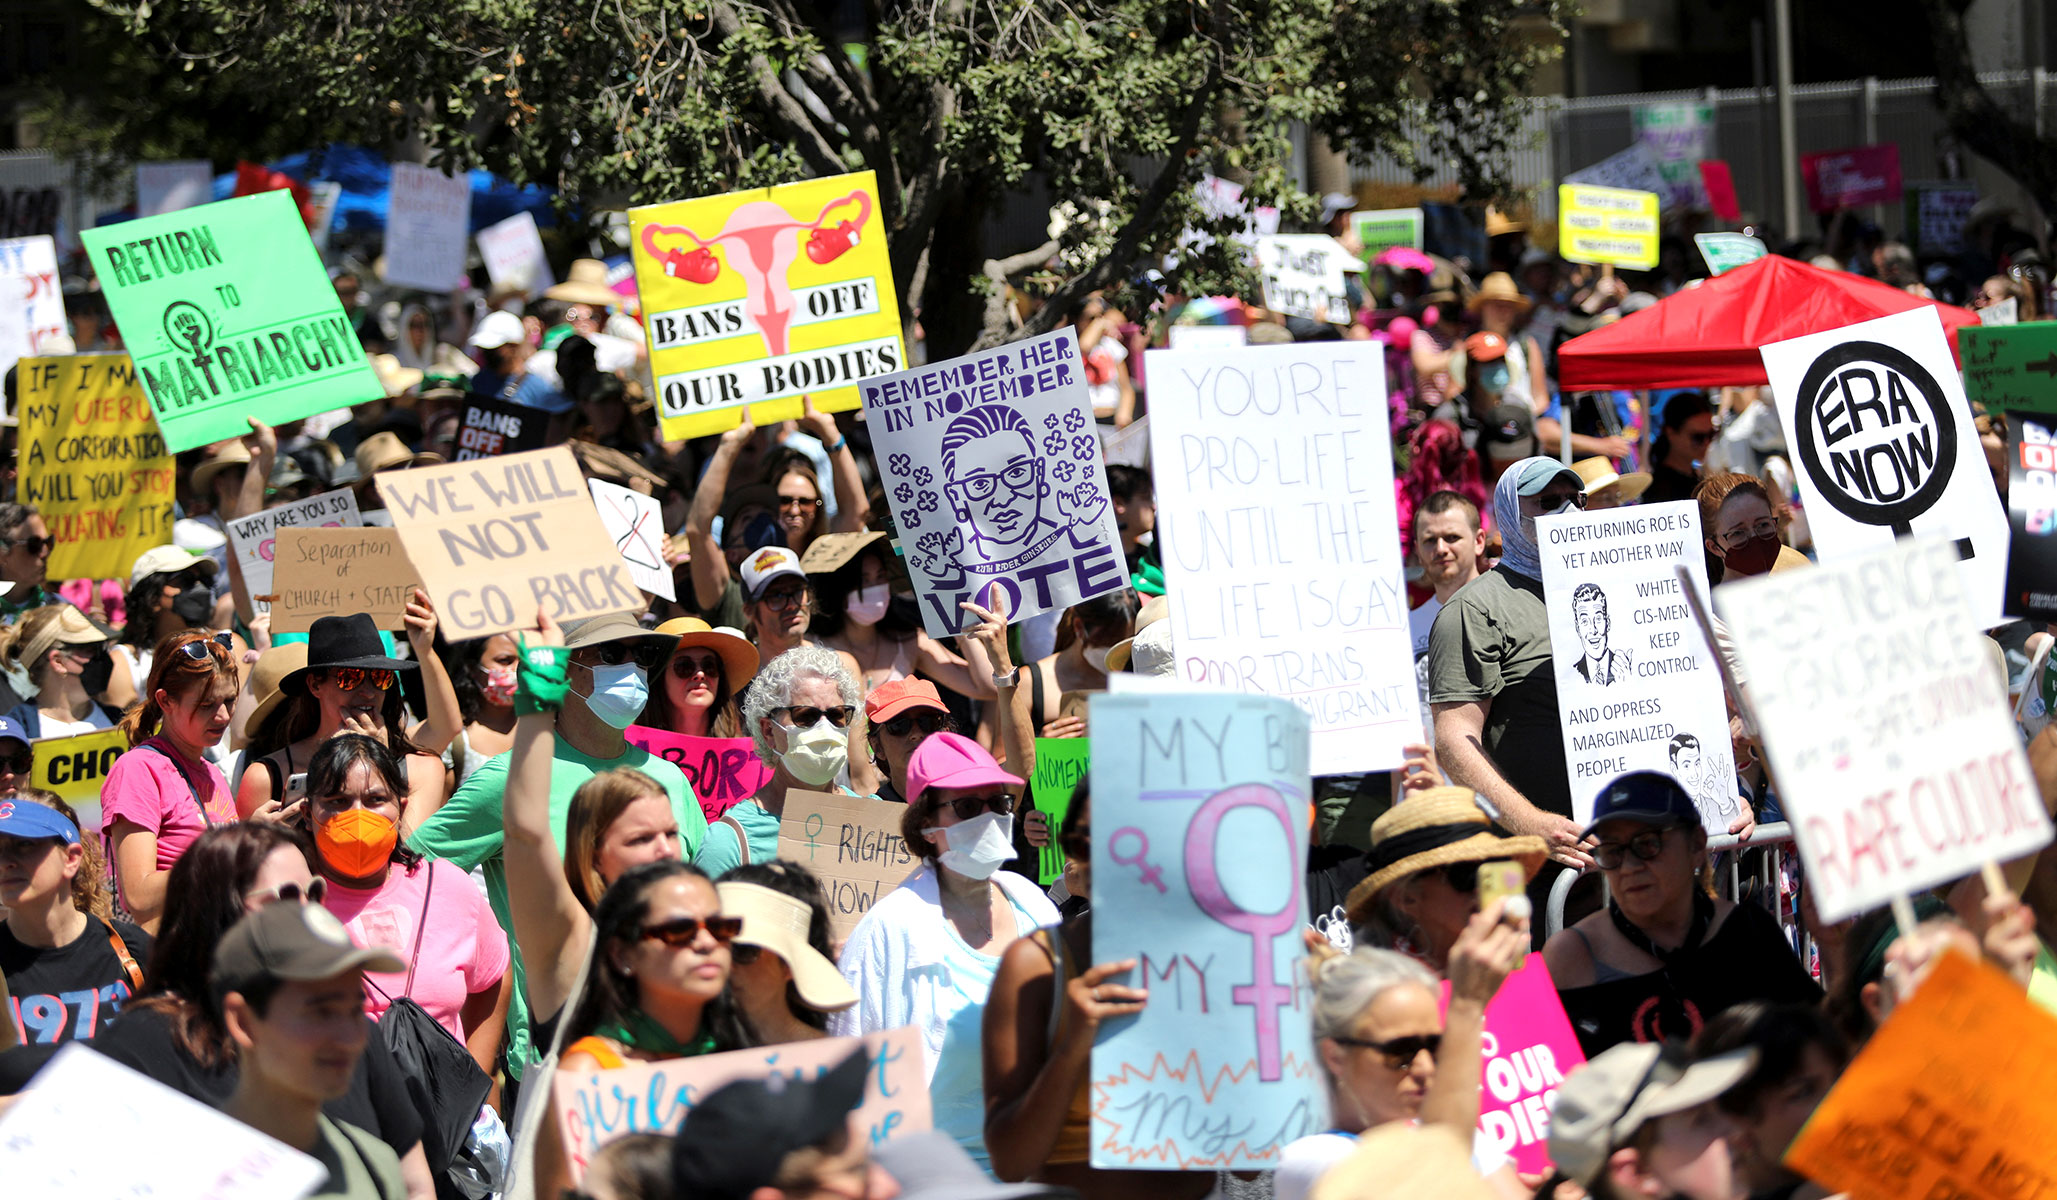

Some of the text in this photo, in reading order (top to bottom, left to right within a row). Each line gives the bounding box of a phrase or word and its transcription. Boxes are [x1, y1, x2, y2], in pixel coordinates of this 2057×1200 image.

[106, 226, 222, 286] RETURN
[216, 285, 241, 309] TO
[655, 283, 869, 345] BANS OFF
[31, 365, 59, 392] IF
[78, 365, 93, 390] I
[142, 317, 360, 412] MATRIARCHY
[665, 344, 898, 411] OUR BODIES
[866, 336, 1073, 408] REMEMBER HER
[884, 363, 1073, 433] IN NOVEMBER
[1181, 360, 1362, 420] YOU'RE
[1815, 368, 1921, 447] ERA
[28, 396, 152, 428] MY UTERU
[466, 406, 522, 438] BANS
[29, 439, 45, 464] A
[461, 427, 502, 453] OFF
[1180, 431, 1366, 493] PRO-LIFE
[1829, 424, 1933, 503] NOW
[26, 469, 174, 502] WILL YOU STOP
[386, 459, 578, 520] WE WILL
[44, 504, 173, 543] GULATING IT?
[235, 496, 348, 540] WHY ARE YOU SO
[1170, 501, 1378, 572] UNTIL THE
[1550, 514, 1690, 544] OVERTURNING ROE IS
[297, 536, 391, 565] Separation
[437, 511, 550, 567] NOT
[1021, 533, 1058, 563] GINSBURG
[1562, 541, 1684, 569] YET ANOTHER WAY
[337, 561, 351, 576] of
[1636, 578, 1679, 597] WHITE
[285, 589, 340, 609] CHURCH
[363, 584, 418, 608] STATE
[448, 584, 515, 631] GO
[529, 564, 640, 620] BACK
[923, 544, 1123, 635] VOTE
[1181, 583, 1279, 640] LIFE
[1292, 580, 1333, 632] IS
[1634, 604, 1689, 625] CIS-MEN
[1650, 631, 1680, 649] KEEP
[1638, 656, 1699, 677] CONTROL
[1291, 684, 1408, 726] MIGRANT.
[1569, 698, 1661, 725] AND OPPRESS
[1140, 714, 1232, 787] MY
[1573, 723, 1674, 751] MARGINALIZED
[48, 746, 120, 785] CHO
[1577, 757, 1627, 778] PEOPLE
[838, 823, 912, 868] RIGHTS
[1140, 952, 1215, 1014] MY
[1487, 1044, 1564, 1102] OUR
